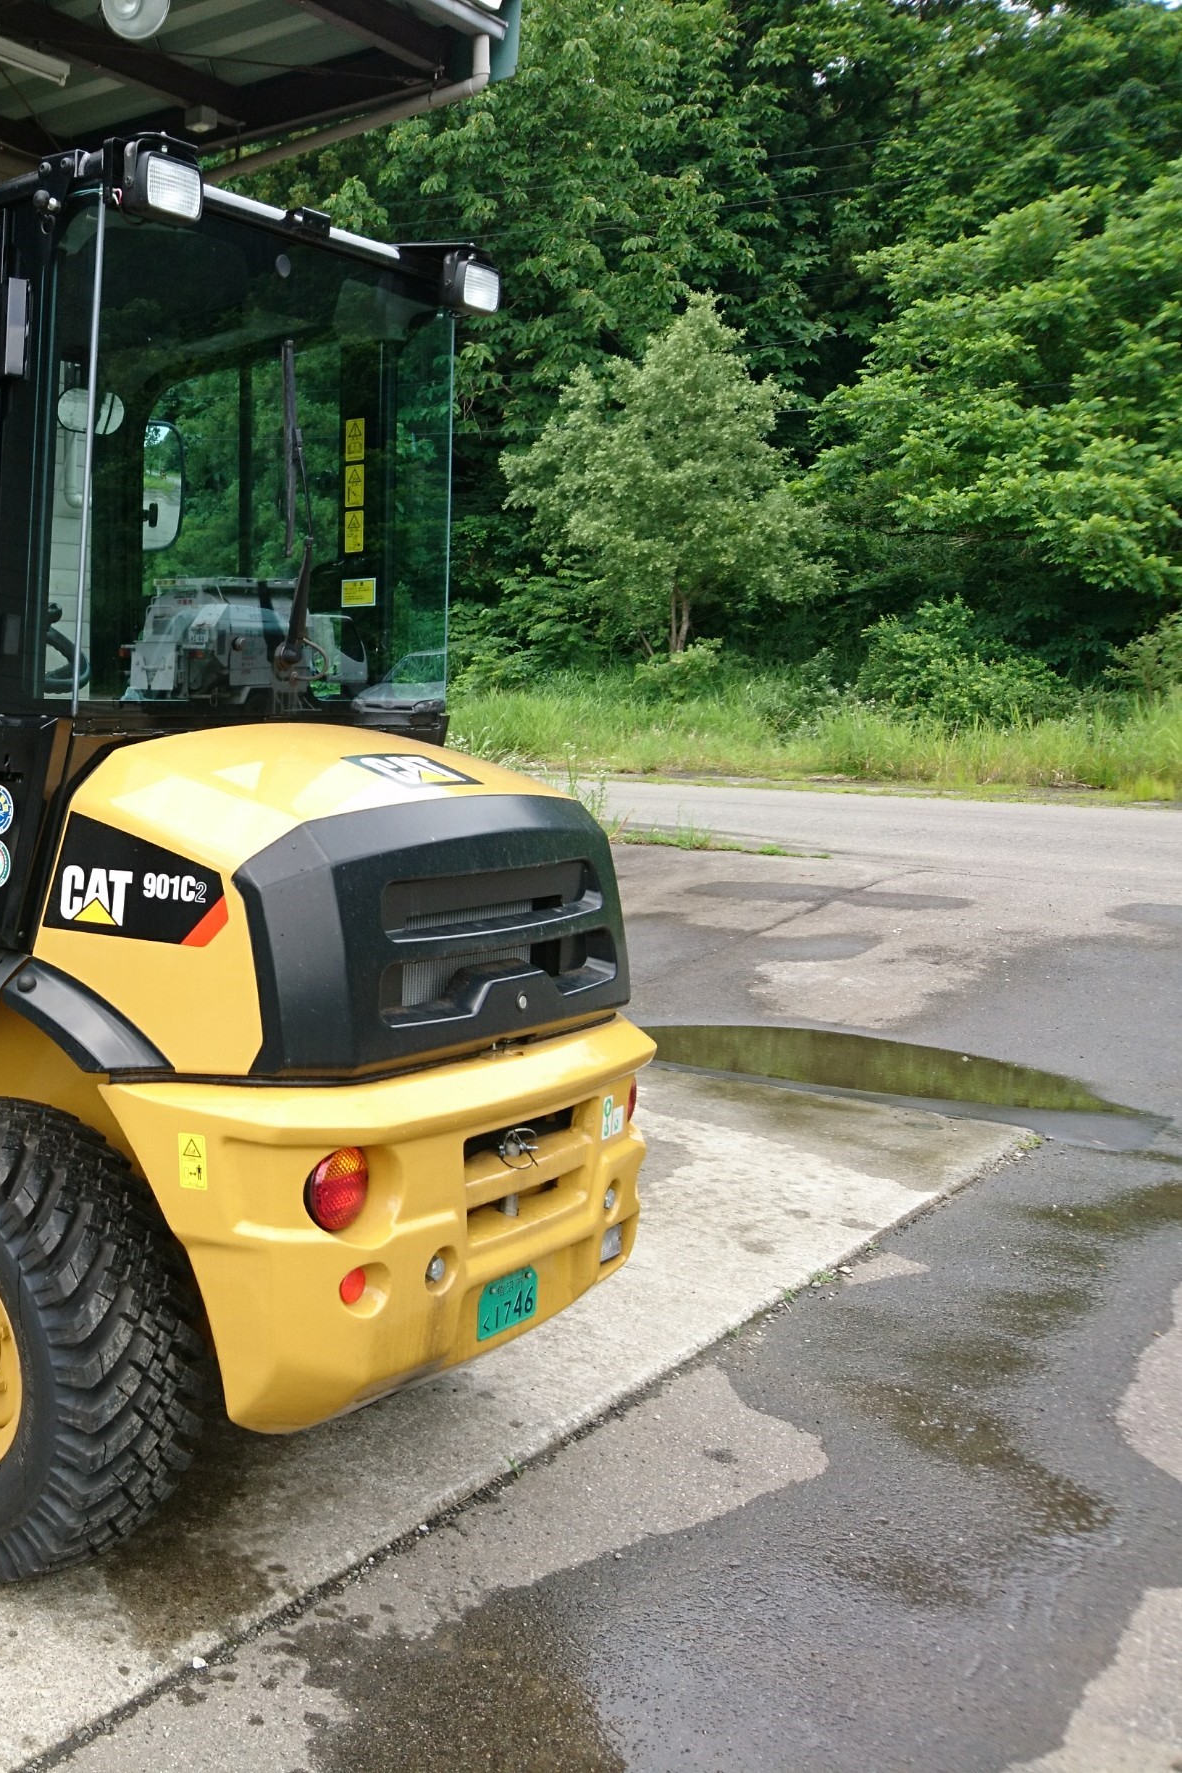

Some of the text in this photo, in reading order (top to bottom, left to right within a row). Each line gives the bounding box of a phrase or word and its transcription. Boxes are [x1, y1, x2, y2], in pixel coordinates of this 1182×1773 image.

[359, 756, 467, 784] CAT
[59, 864, 207, 926] CAT 901C2
[495, 1285, 533, 1329] 1746
